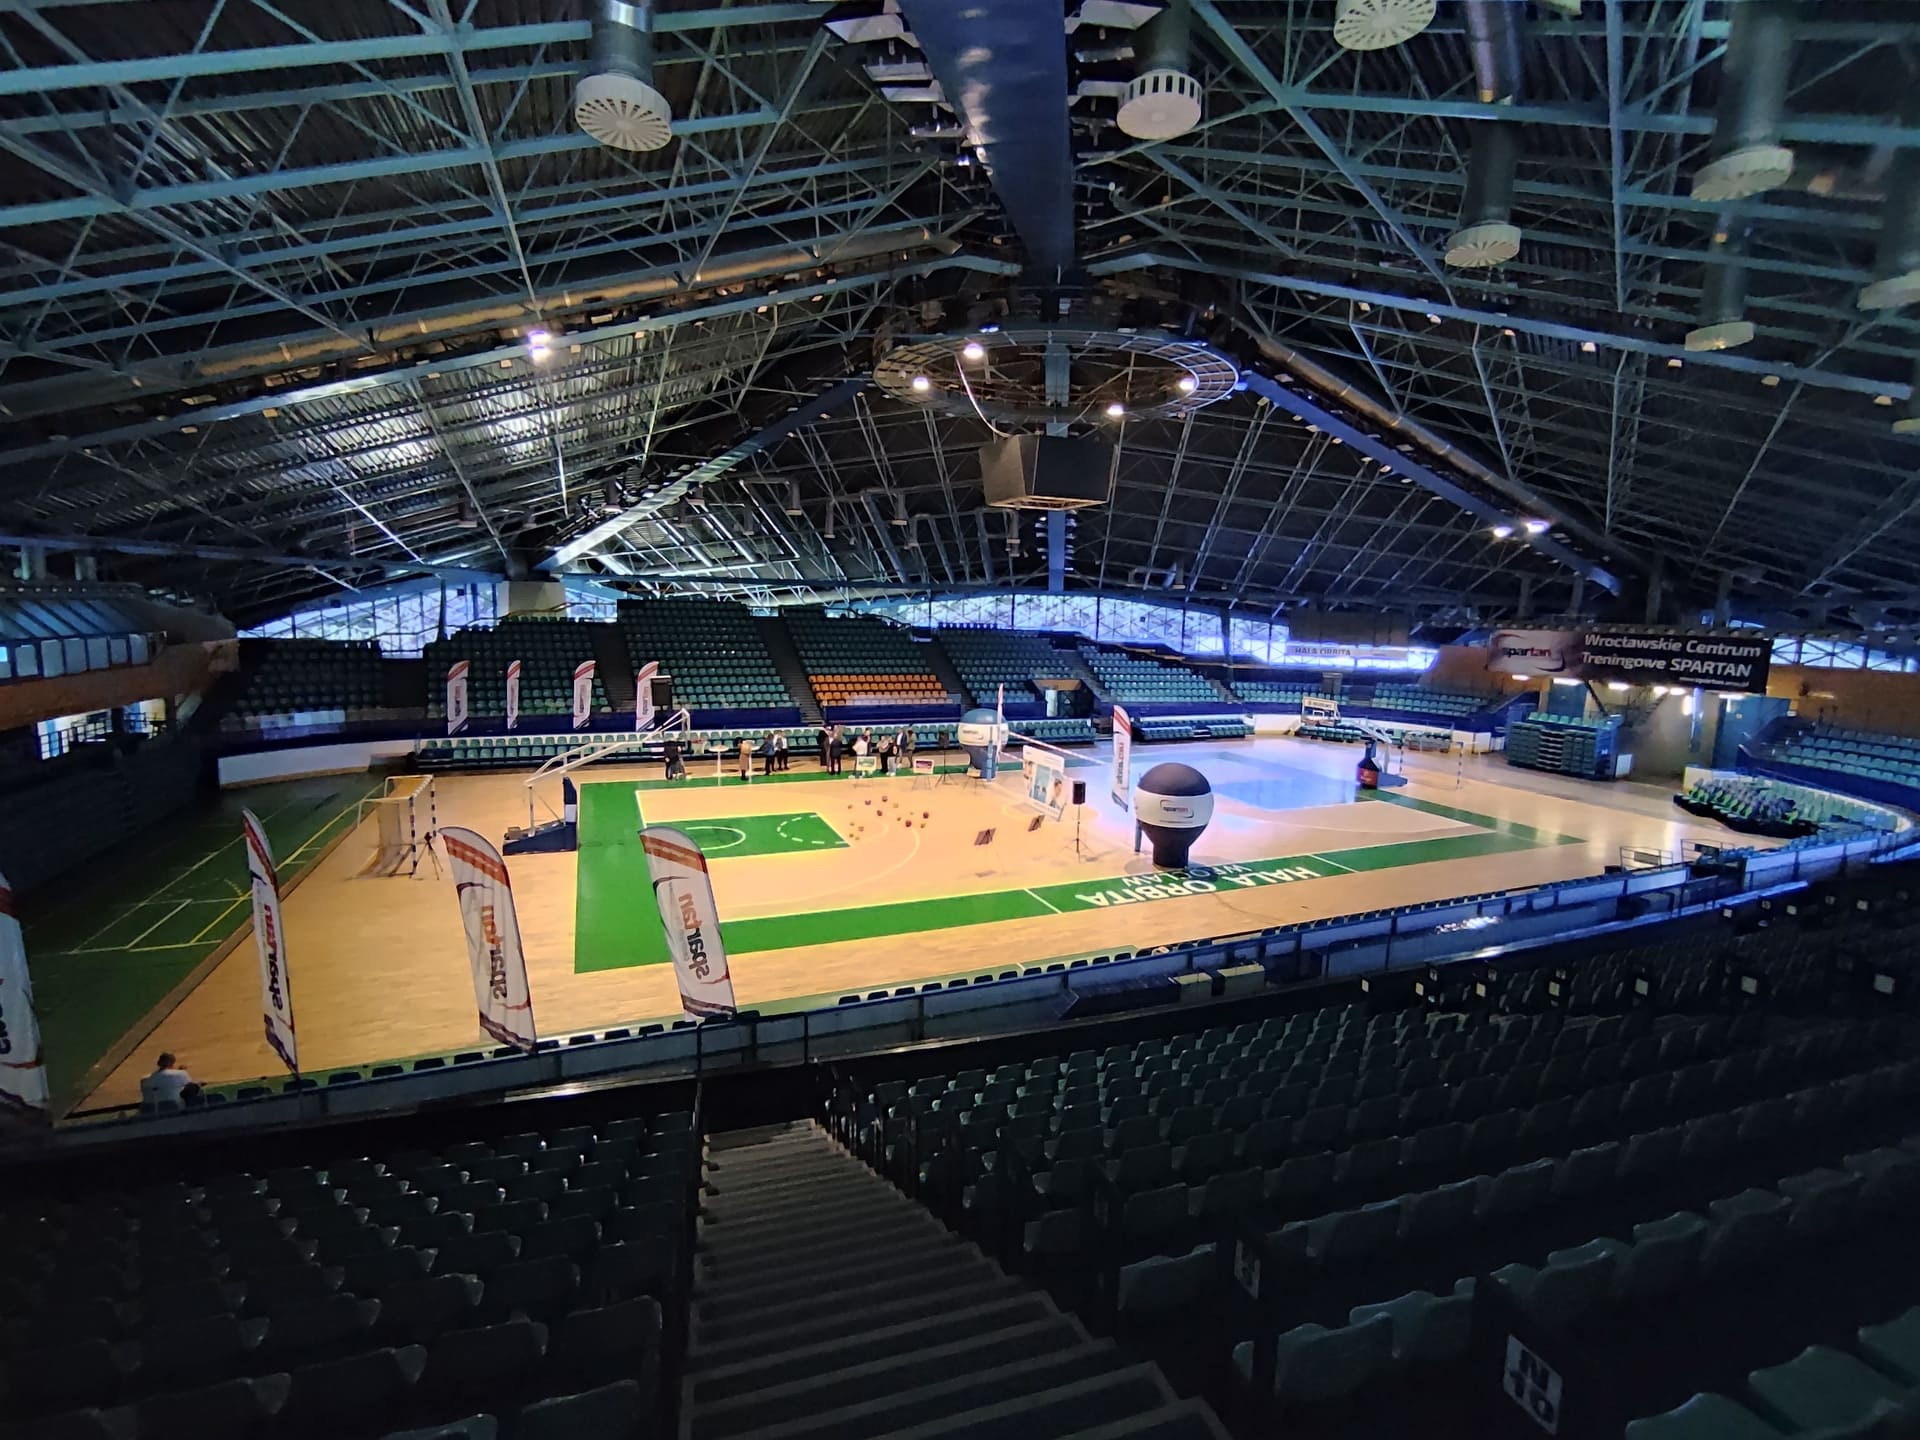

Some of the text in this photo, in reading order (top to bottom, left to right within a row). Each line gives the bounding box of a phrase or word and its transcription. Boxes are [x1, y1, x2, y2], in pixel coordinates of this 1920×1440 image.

[1502, 647, 1552, 658] spartan
[1686, 640, 1761, 658] Centrum
[1581, 652, 1753, 678] Treningowe SPARTAN
[1075, 866, 1321, 907] HALA ORBITA
